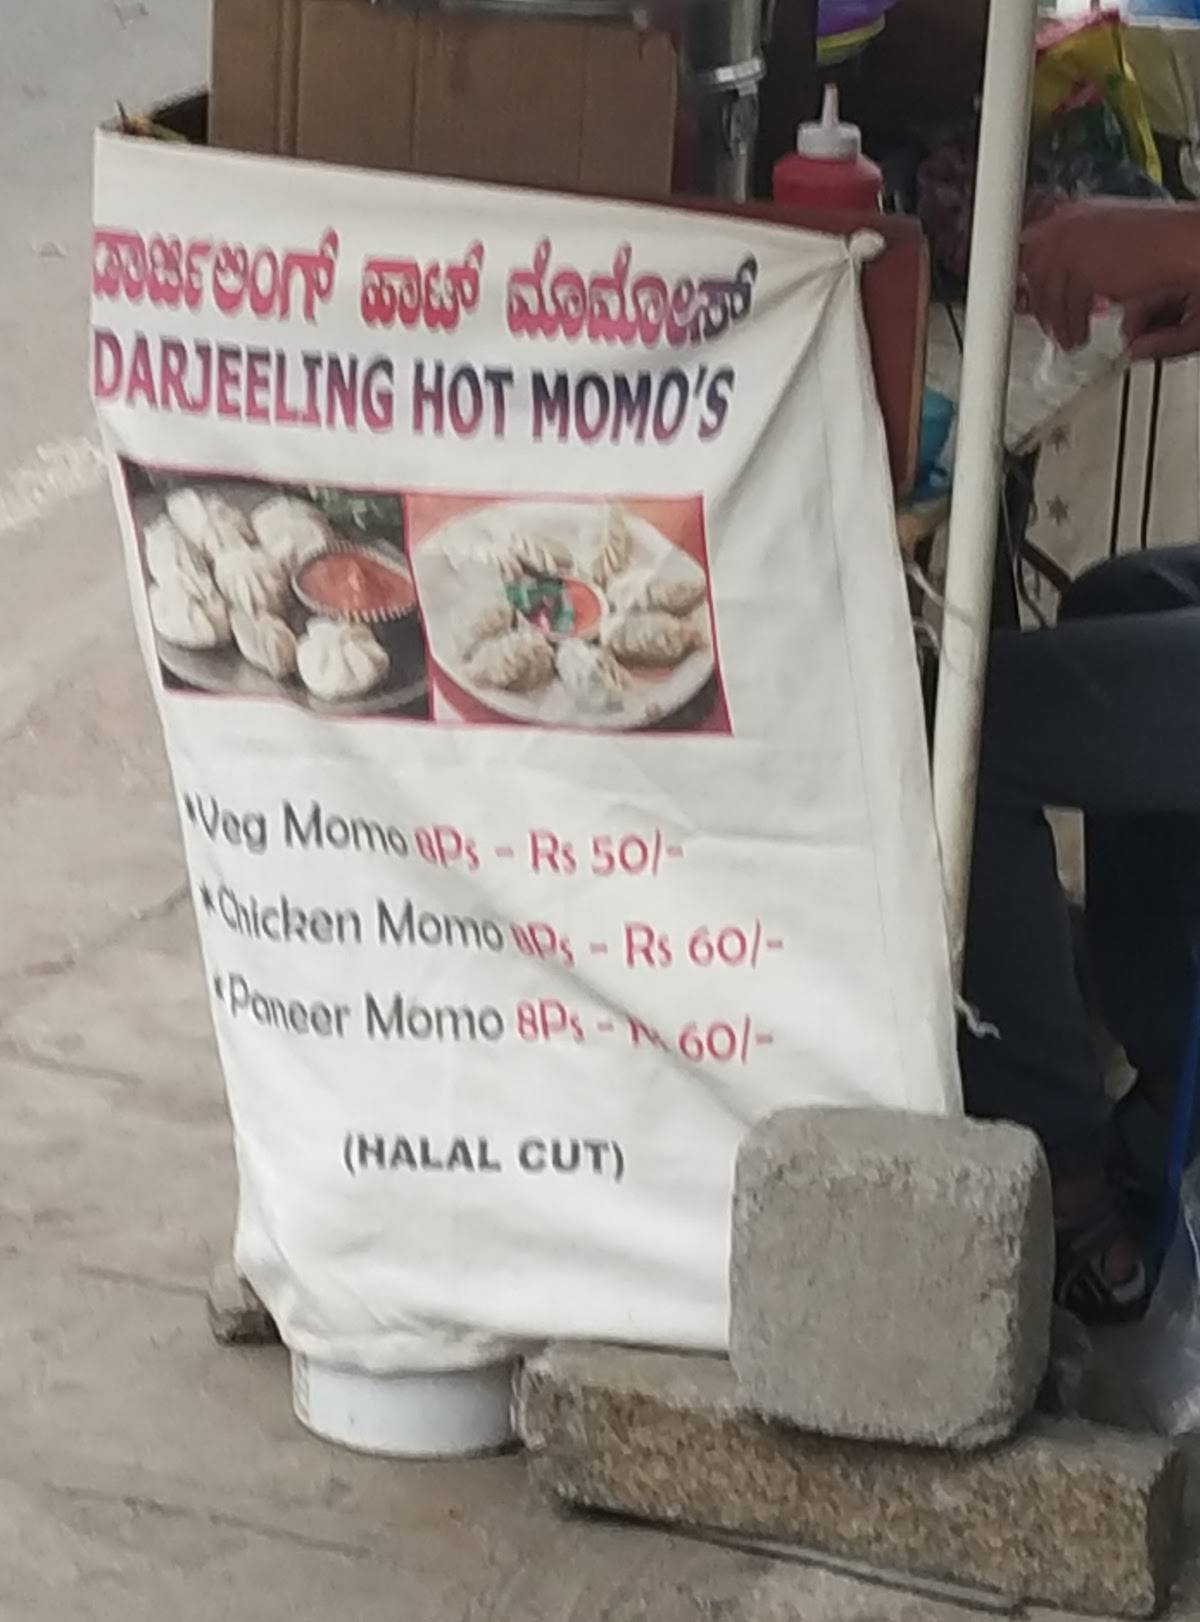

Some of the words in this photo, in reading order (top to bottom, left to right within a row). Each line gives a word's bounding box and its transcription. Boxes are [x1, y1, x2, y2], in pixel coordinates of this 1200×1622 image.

[360, 240, 484, 332] ಹಾಟ್
[93, 328, 394, 432] DARJEELING
[412, 359, 513, 437] HOT
[531, 362, 735, 445] MOMO'S
[195, 793, 268, 855] Veg
[281, 798, 408, 858] Momo
[529, 829, 577, 875] Rs
[592, 828, 684, 876] 50/-
[217, 884, 362, 944] Chicken
[375, 896, 505, 952] Momo
[624, 922, 673, 969] Rs
[688, 920, 784, 970] 60/-
[228, 971, 352, 1039] Paneer
[363, 990, 505, 1042] Momo
[516, 998, 585, 1044] 8Ps
[678, 1014, 774, 1065] 60/-
[343, 1130, 503, 1177] (HALAL
[518, 1136, 625, 1182] CUT)
